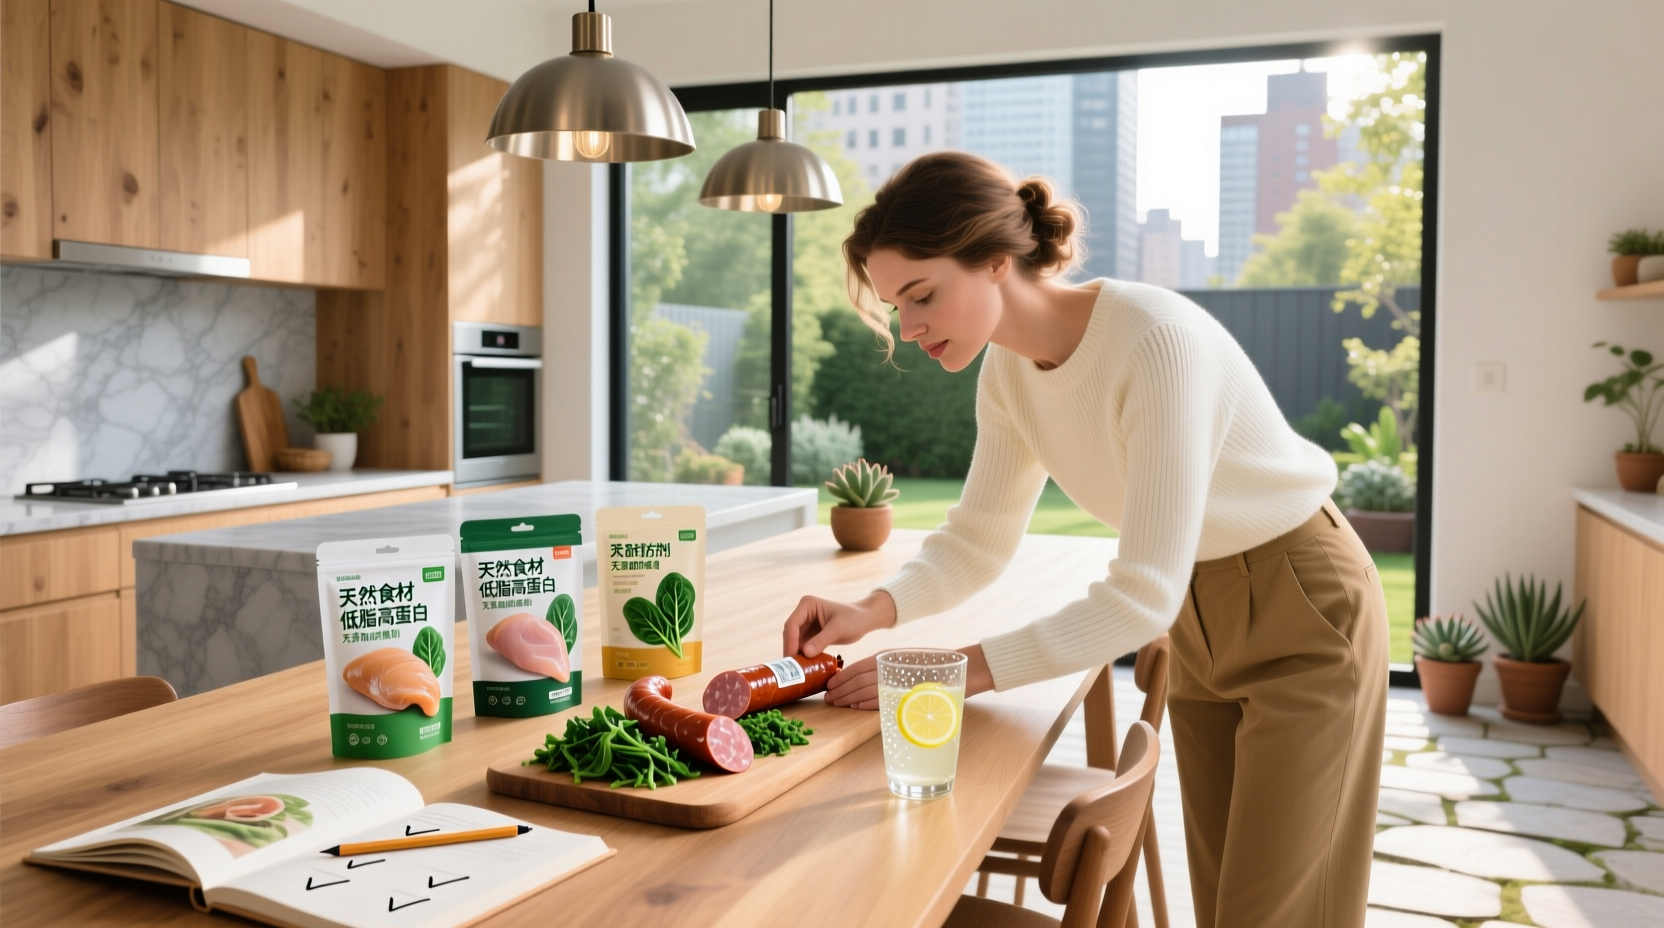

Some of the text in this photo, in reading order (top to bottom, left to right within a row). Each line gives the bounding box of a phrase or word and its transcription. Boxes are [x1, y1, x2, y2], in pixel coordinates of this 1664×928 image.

[478, 557, 544, 579] 天然食材
[339, 581, 415, 608] 天然食材
